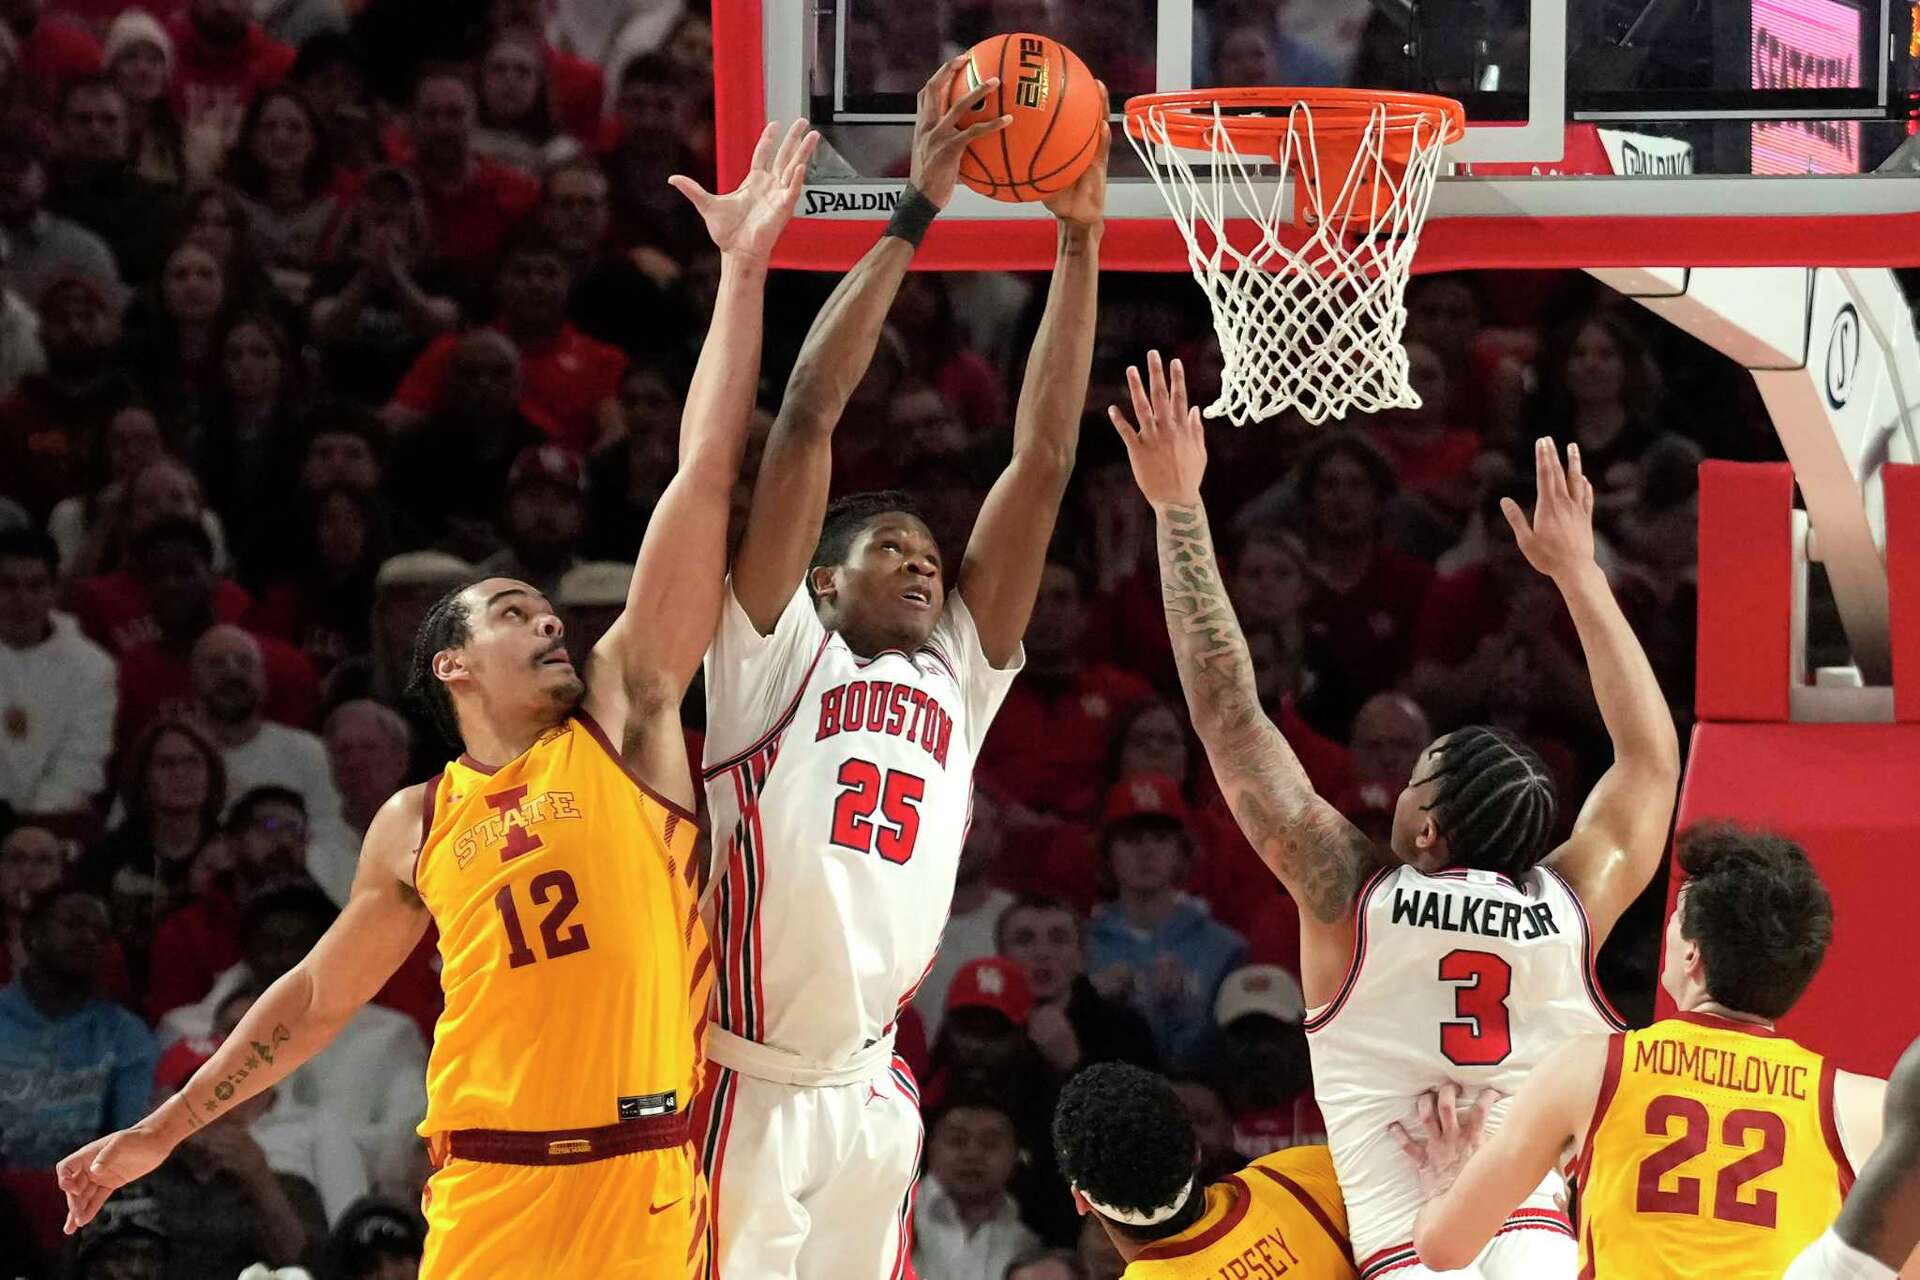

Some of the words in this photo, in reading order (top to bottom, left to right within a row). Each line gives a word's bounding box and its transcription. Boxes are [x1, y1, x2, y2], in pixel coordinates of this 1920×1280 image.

[1016, 37, 1044, 108] ELITE
[805, 190, 901, 215] SPALDIN
[815, 680, 953, 772] HOUSTON
[453, 791, 582, 871] STATE
[829, 757, 925, 866] 25
[494, 869, 591, 969] 12
[1438, 948, 1513, 1066] 3
[1633, 1039, 1808, 1101] MOMCILOVIC
[1635, 1094, 1787, 1230] 22
[1206, 1227, 1299, 1280] PSEY
